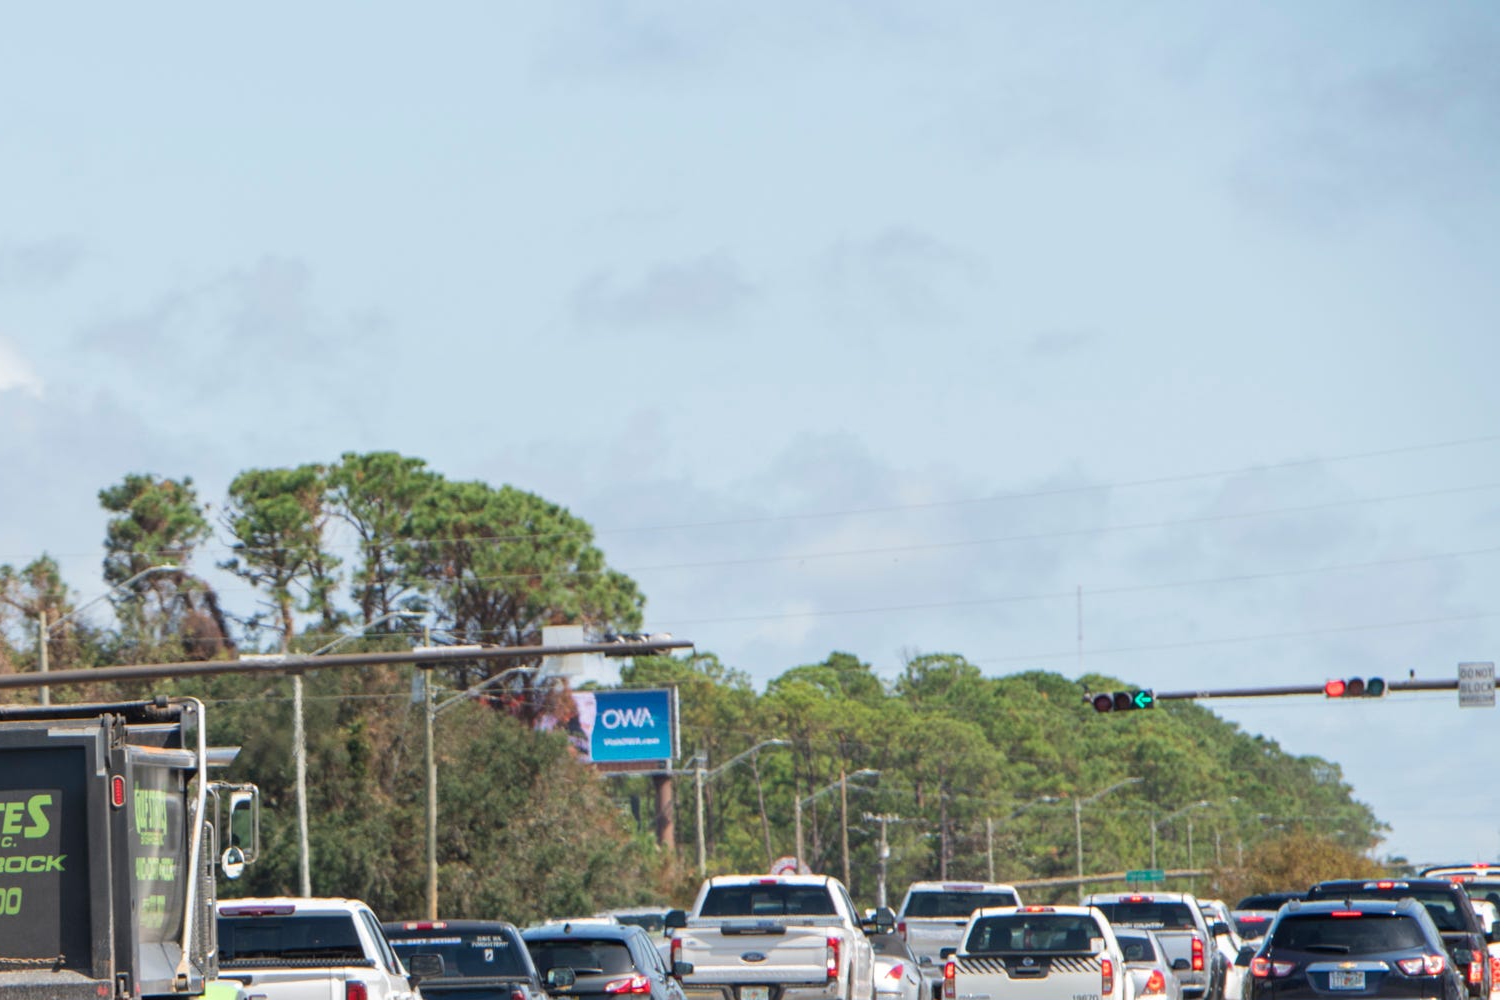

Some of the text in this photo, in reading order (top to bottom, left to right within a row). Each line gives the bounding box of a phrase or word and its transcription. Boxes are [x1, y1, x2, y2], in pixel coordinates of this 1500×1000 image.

[1475, 668, 1493, 679] NOT
[1460, 682, 1493, 693] BLOCK
[602, 707, 654, 729] OWA
